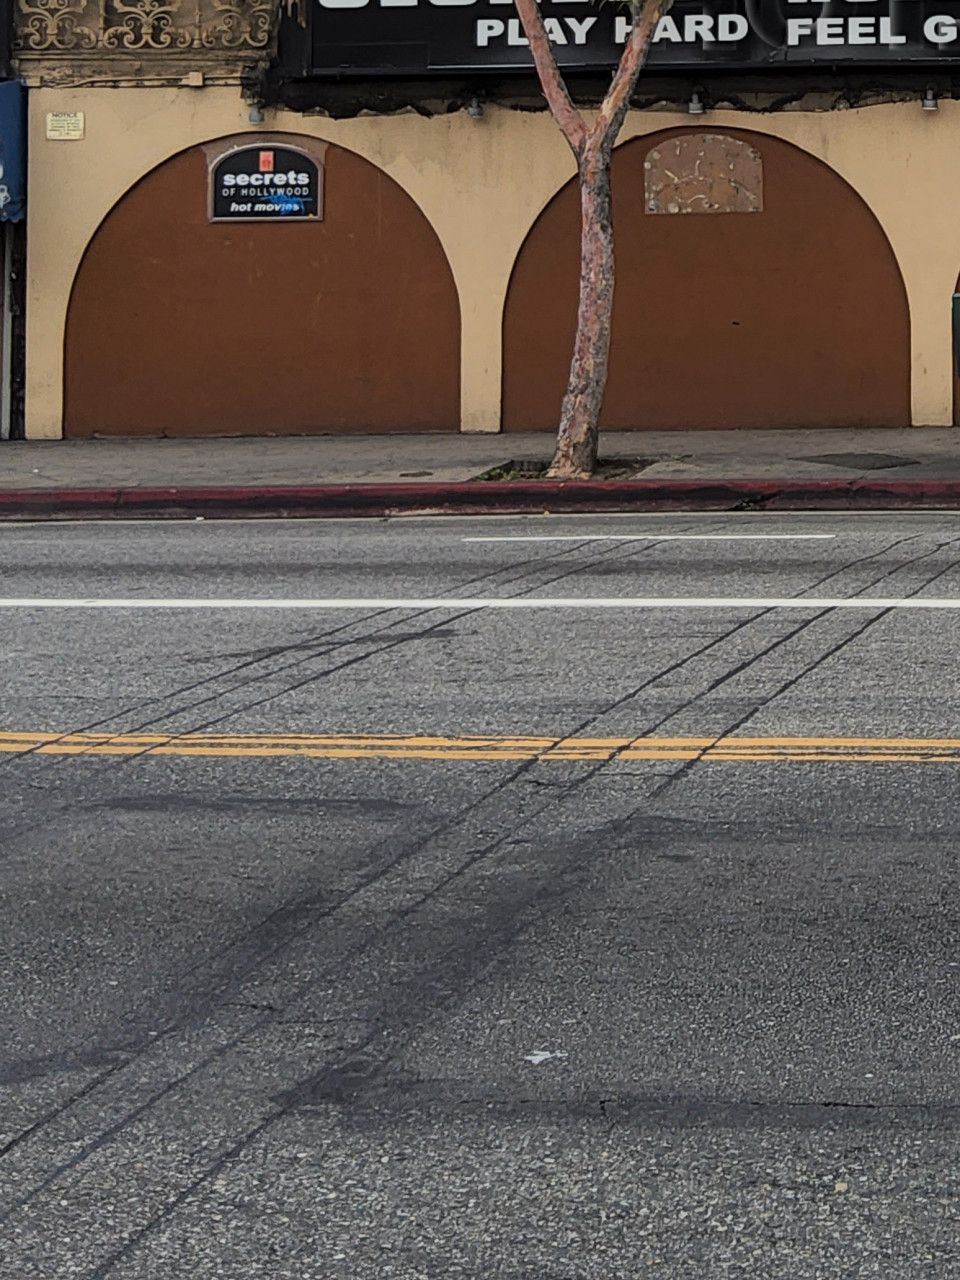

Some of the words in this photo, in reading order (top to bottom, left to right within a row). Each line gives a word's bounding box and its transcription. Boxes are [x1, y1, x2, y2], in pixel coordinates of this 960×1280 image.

[476, 17, 598, 47] PLAY
[614, 14, 748, 45] HARD
[787, 16, 906, 46] FEEL
[223, 170, 310, 186] secrets
[222, 188, 236, 197] OF
[241, 187, 310, 197] HOLLYWOOD
[230, 202, 252, 212] hot
[254, 202, 300, 212] movies
